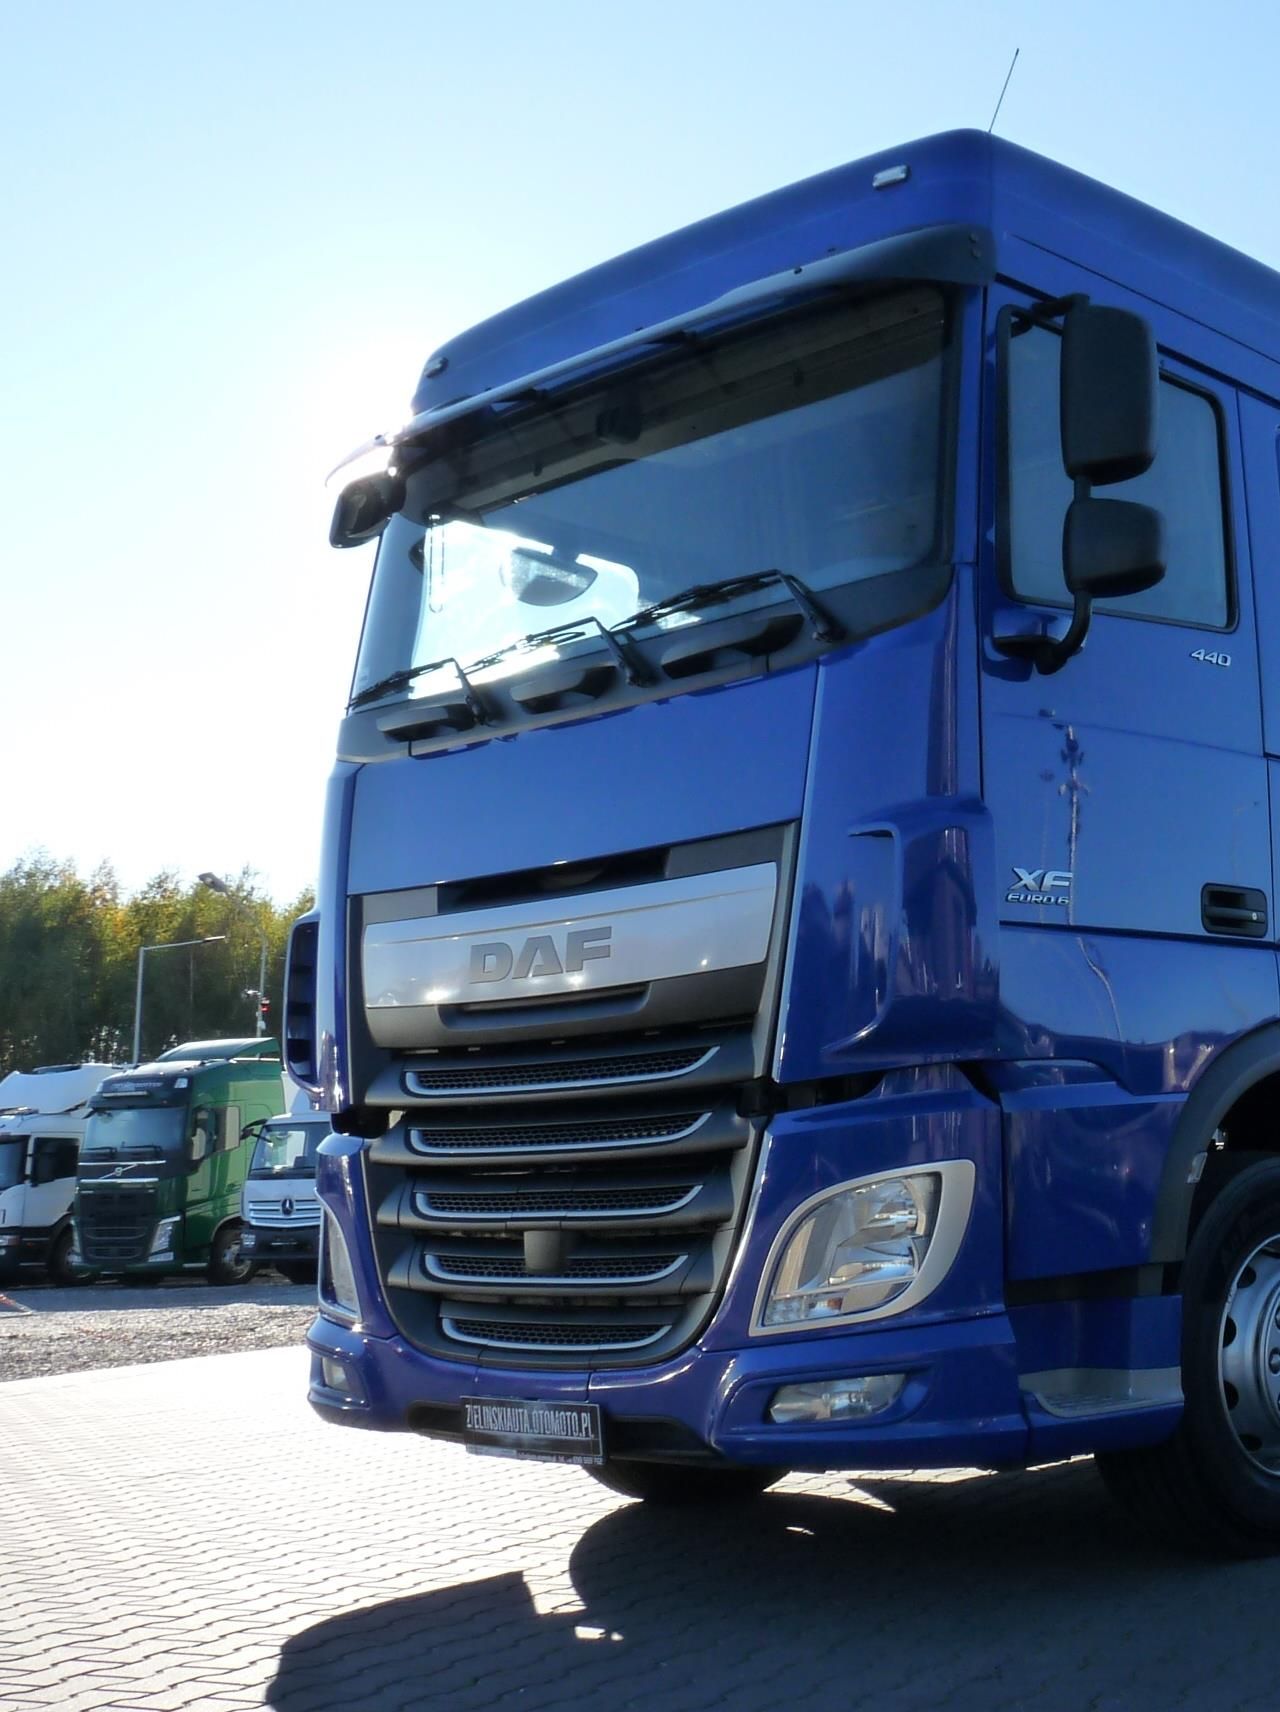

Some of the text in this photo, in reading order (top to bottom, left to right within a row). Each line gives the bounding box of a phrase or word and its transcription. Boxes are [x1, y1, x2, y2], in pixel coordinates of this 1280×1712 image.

[1190, 648, 1231, 666] 440
[1010, 867, 1073, 892] XF
[1006, 892, 1070, 906] EURO 6
[469, 926, 612, 984] DAF
